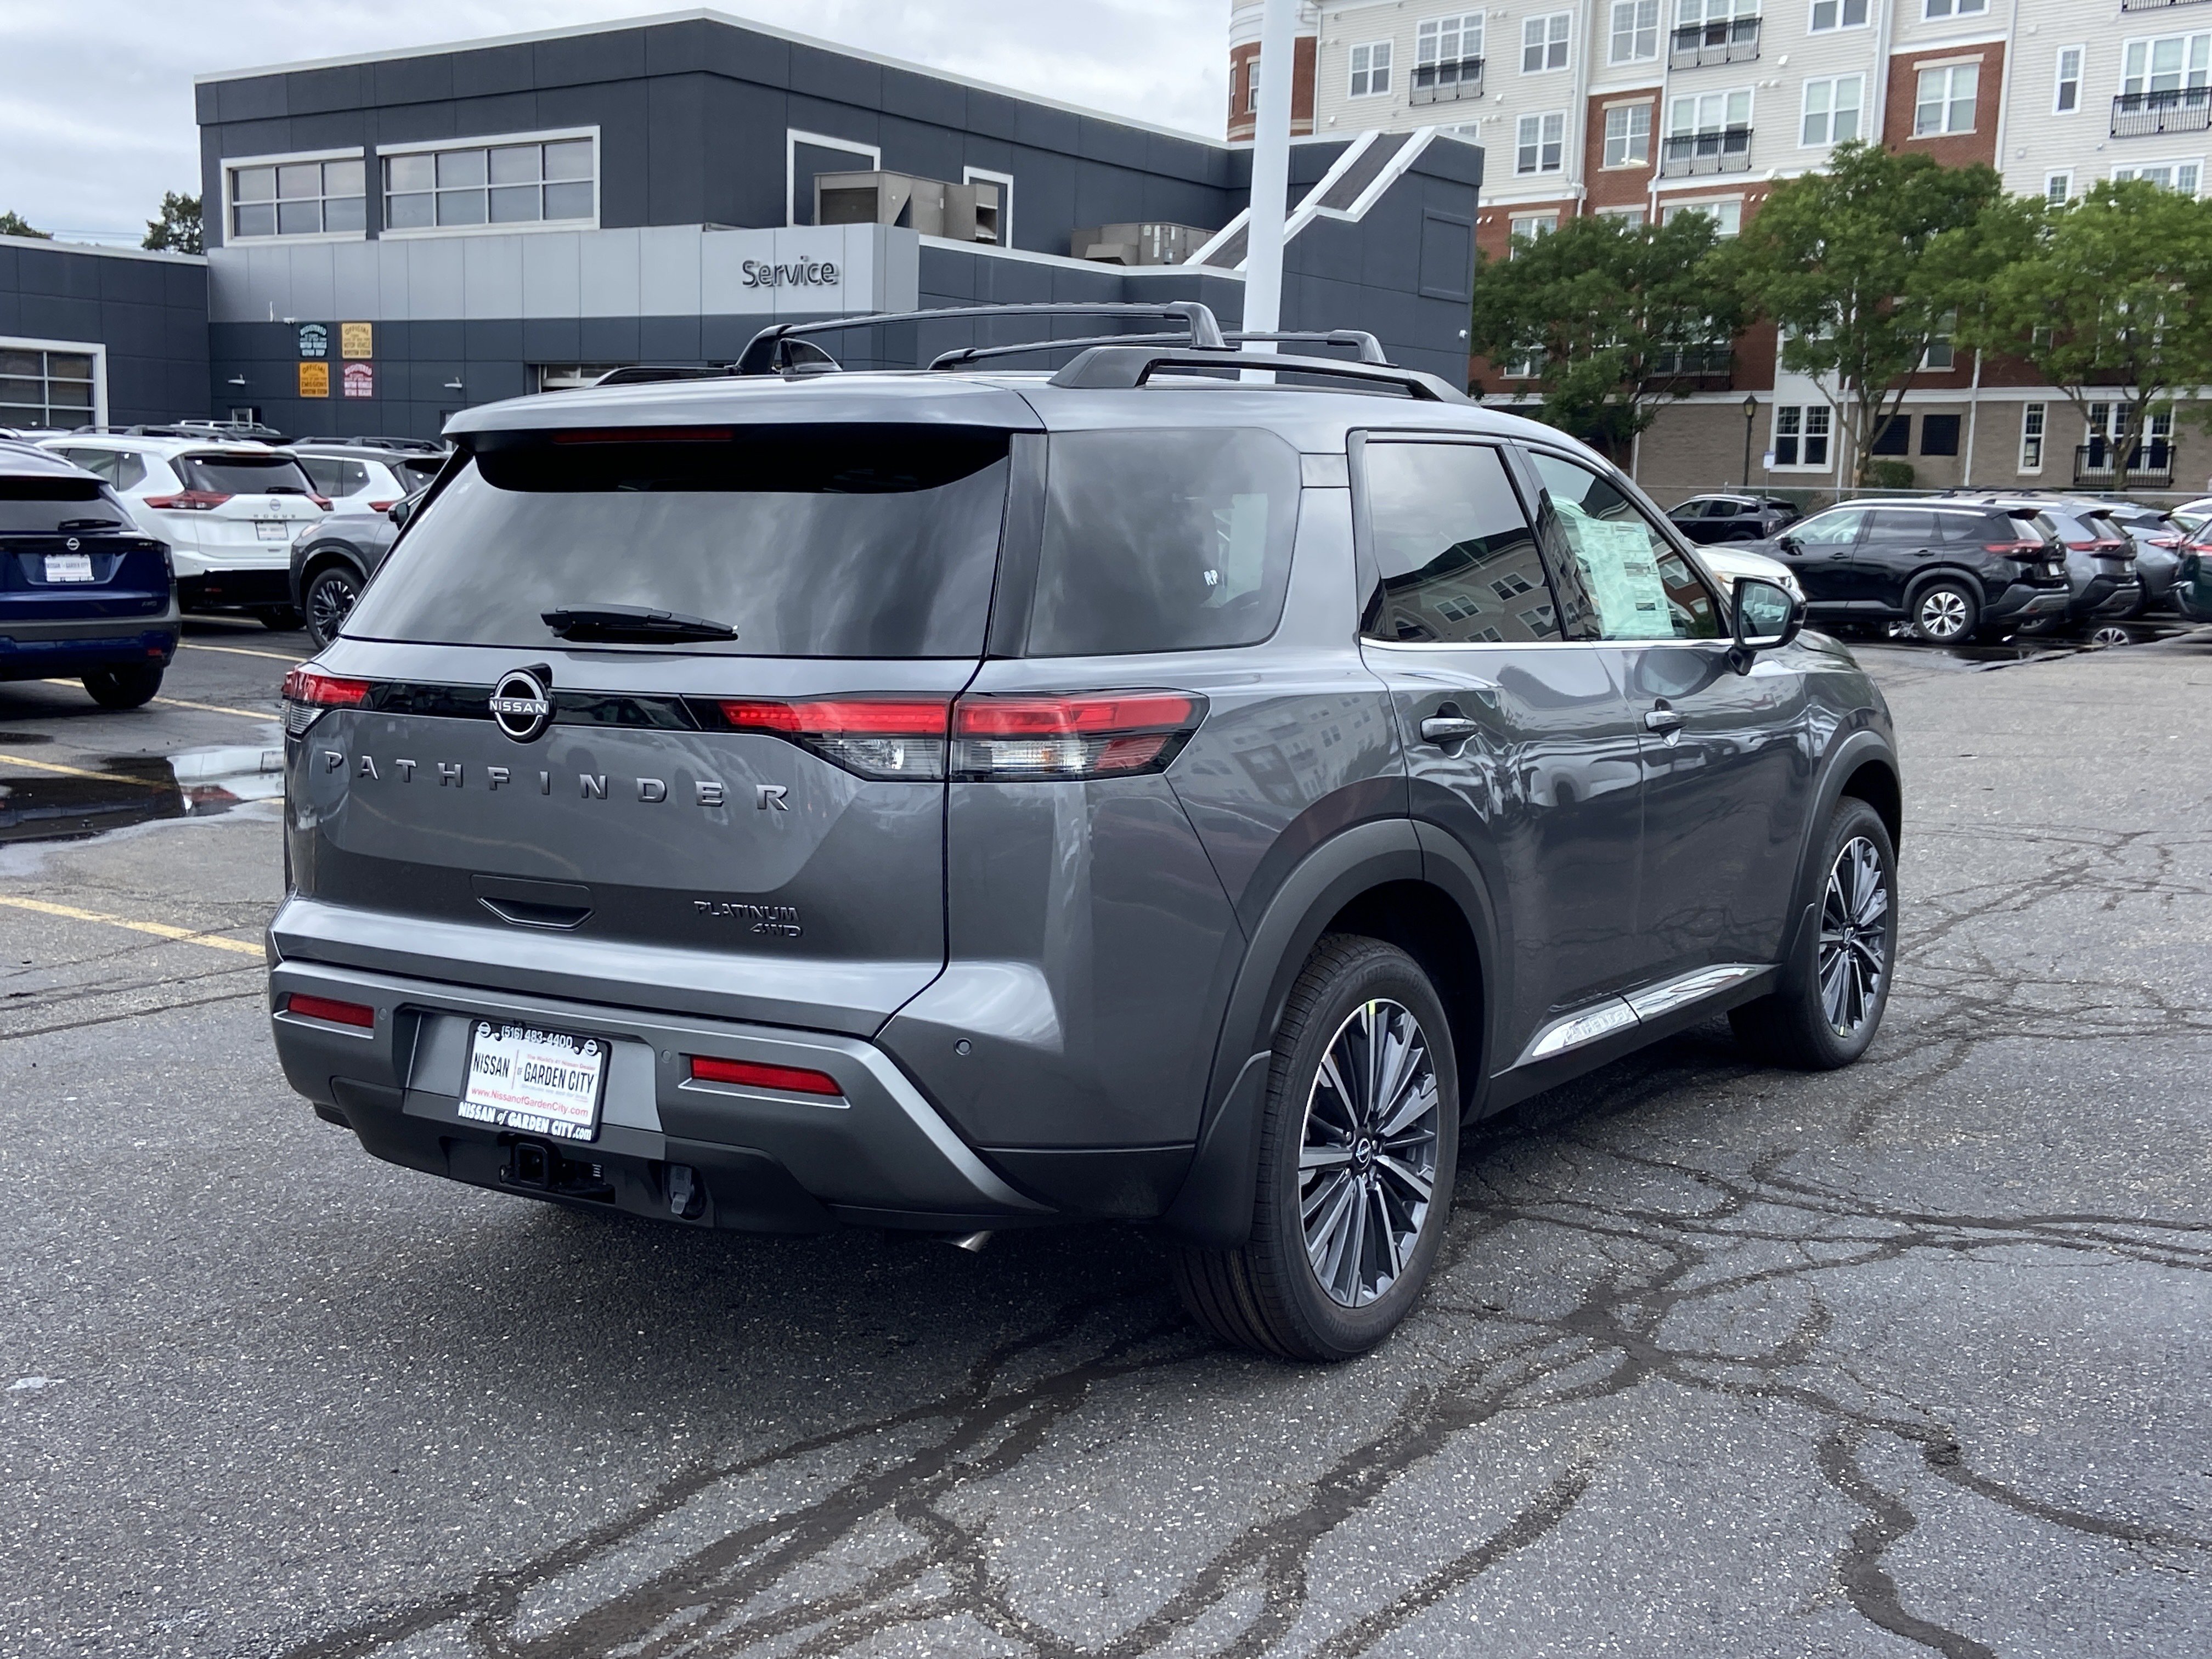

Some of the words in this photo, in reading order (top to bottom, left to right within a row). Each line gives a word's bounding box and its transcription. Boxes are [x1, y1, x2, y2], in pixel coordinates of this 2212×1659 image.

[742, 255, 836, 286] Service
[345, 325, 369, 335] OFFICIAL
[302, 364, 326, 374] OFFICIAL
[489, 699, 546, 713] NISSAN
[325, 751, 789, 811] PATHFINDER
[693, 900, 799, 921] PLATINUM
[750, 923, 803, 937] 4WD
[501, 1025, 523, 1040] (516)
[525, 1029, 573, 1049] 483-4400
[473, 1052, 510, 1078] NISSAN
[524, 1062, 567, 1088] GARDEN
[568, 1070, 595, 1093] CITY
[471, 1087, 589, 1117] www.NissanofGardenCity.com
[458, 1101, 496, 1122] NISSAN
[497, 1110, 509, 1125] of
[508, 1111, 550, 1136] GARDEN
[551, 1122, 592, 1141] CITY.com
